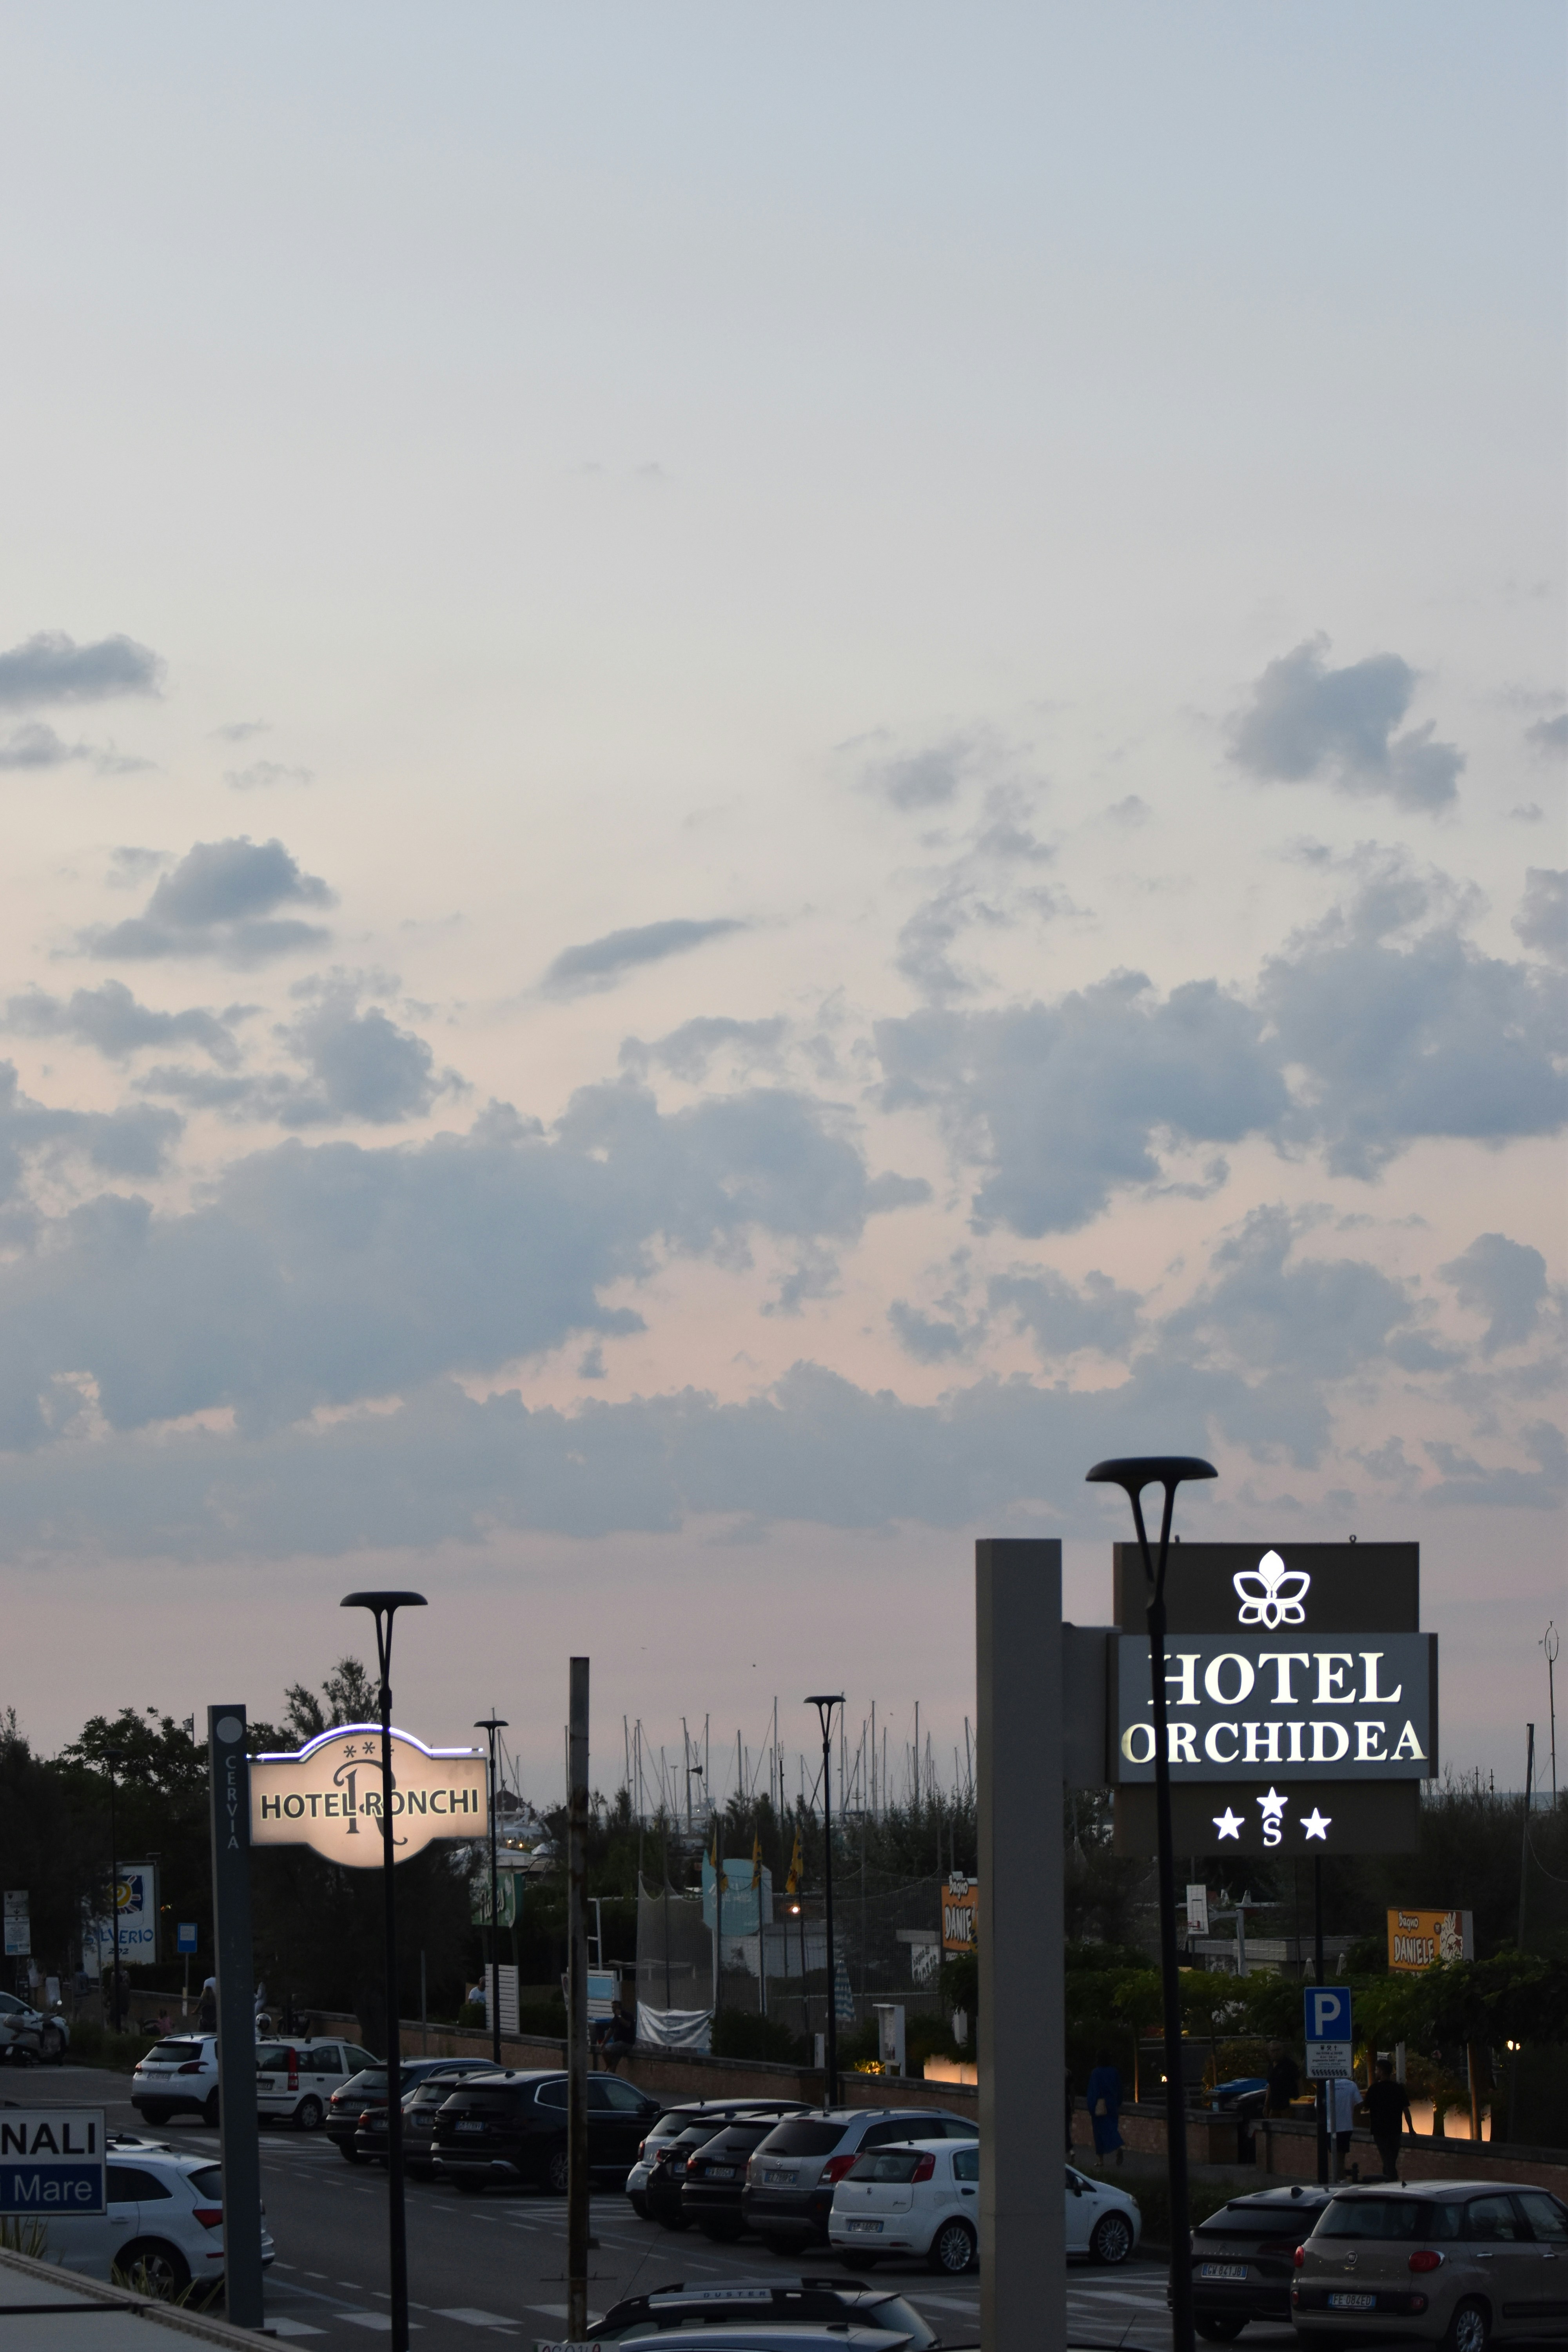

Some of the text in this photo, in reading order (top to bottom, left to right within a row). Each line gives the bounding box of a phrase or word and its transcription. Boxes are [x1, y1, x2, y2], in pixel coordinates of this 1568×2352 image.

[1148, 1653, 1402, 1705] HOTEL
[1121, 1720, 1429, 1764] ORCHIDEA
[225, 1755, 240, 1849] CERVIA
[261, 1789, 478, 1819] HOTEL RONCHI
[1263, 1817, 1282, 1847] S
[1398, 1911, 1419, 1933] Bagno
[1394, 1935, 1435, 1965] DANIELE
[1314, 1993, 1341, 2036] P
[2, 2122, 95, 2154] NALI
[15, 2174, 93, 2201] Mare
[1333, 2295, 1371, 2306] FE 084ED
